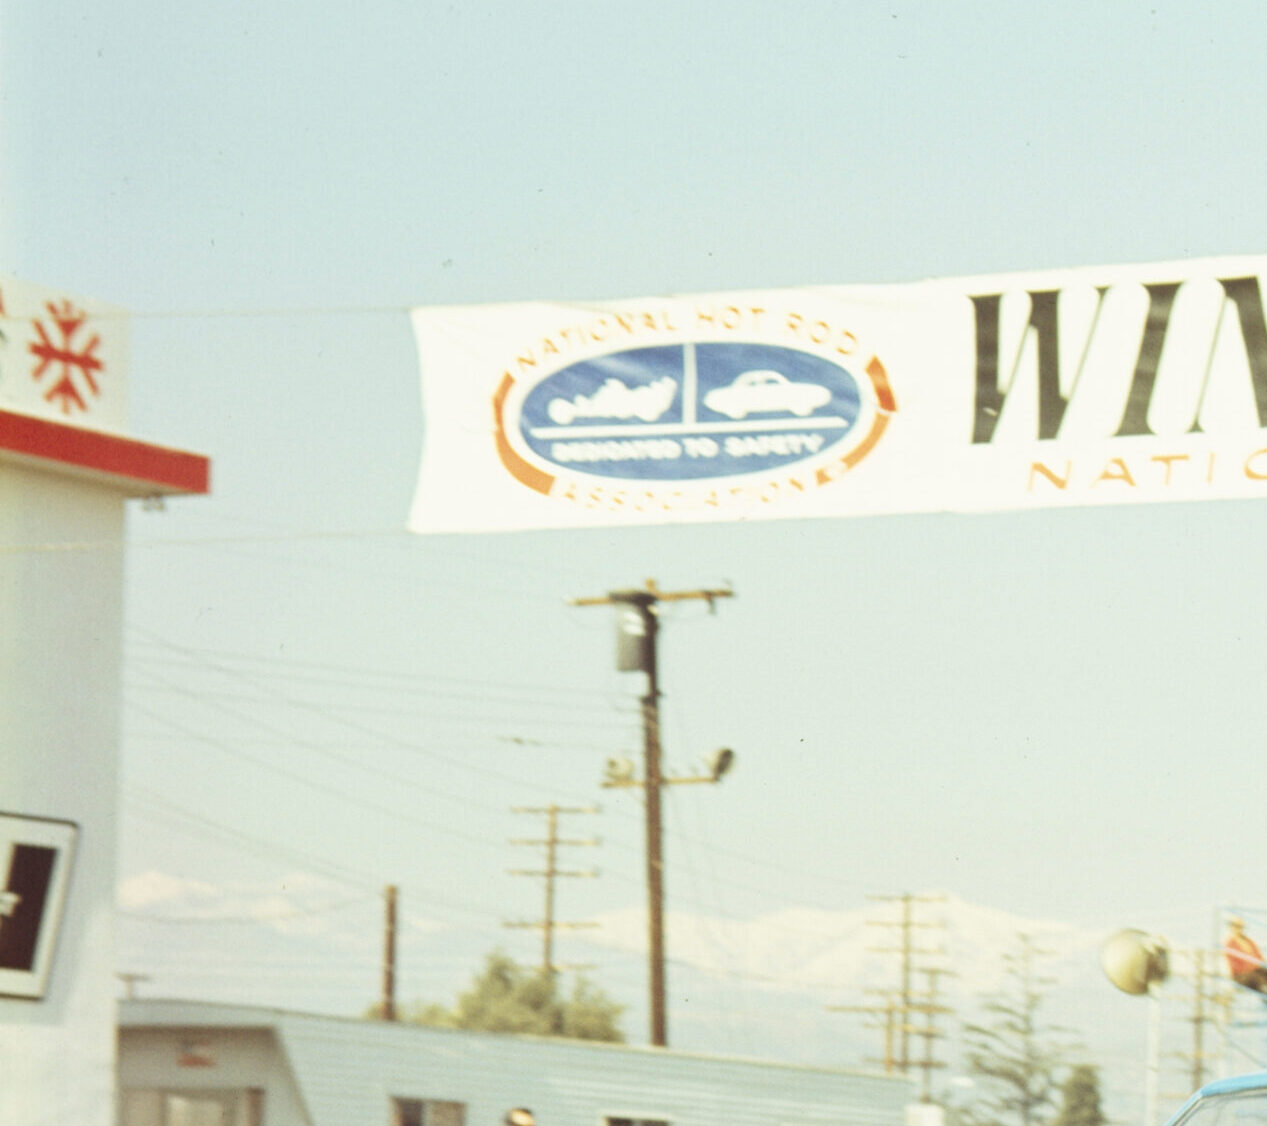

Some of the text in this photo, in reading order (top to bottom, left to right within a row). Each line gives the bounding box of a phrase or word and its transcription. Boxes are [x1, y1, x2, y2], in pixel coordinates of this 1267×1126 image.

[515, 304, 857, 373] NATIONAL HOT ROD
[551, 433, 825, 462] DEDICATED TO SAFETY
